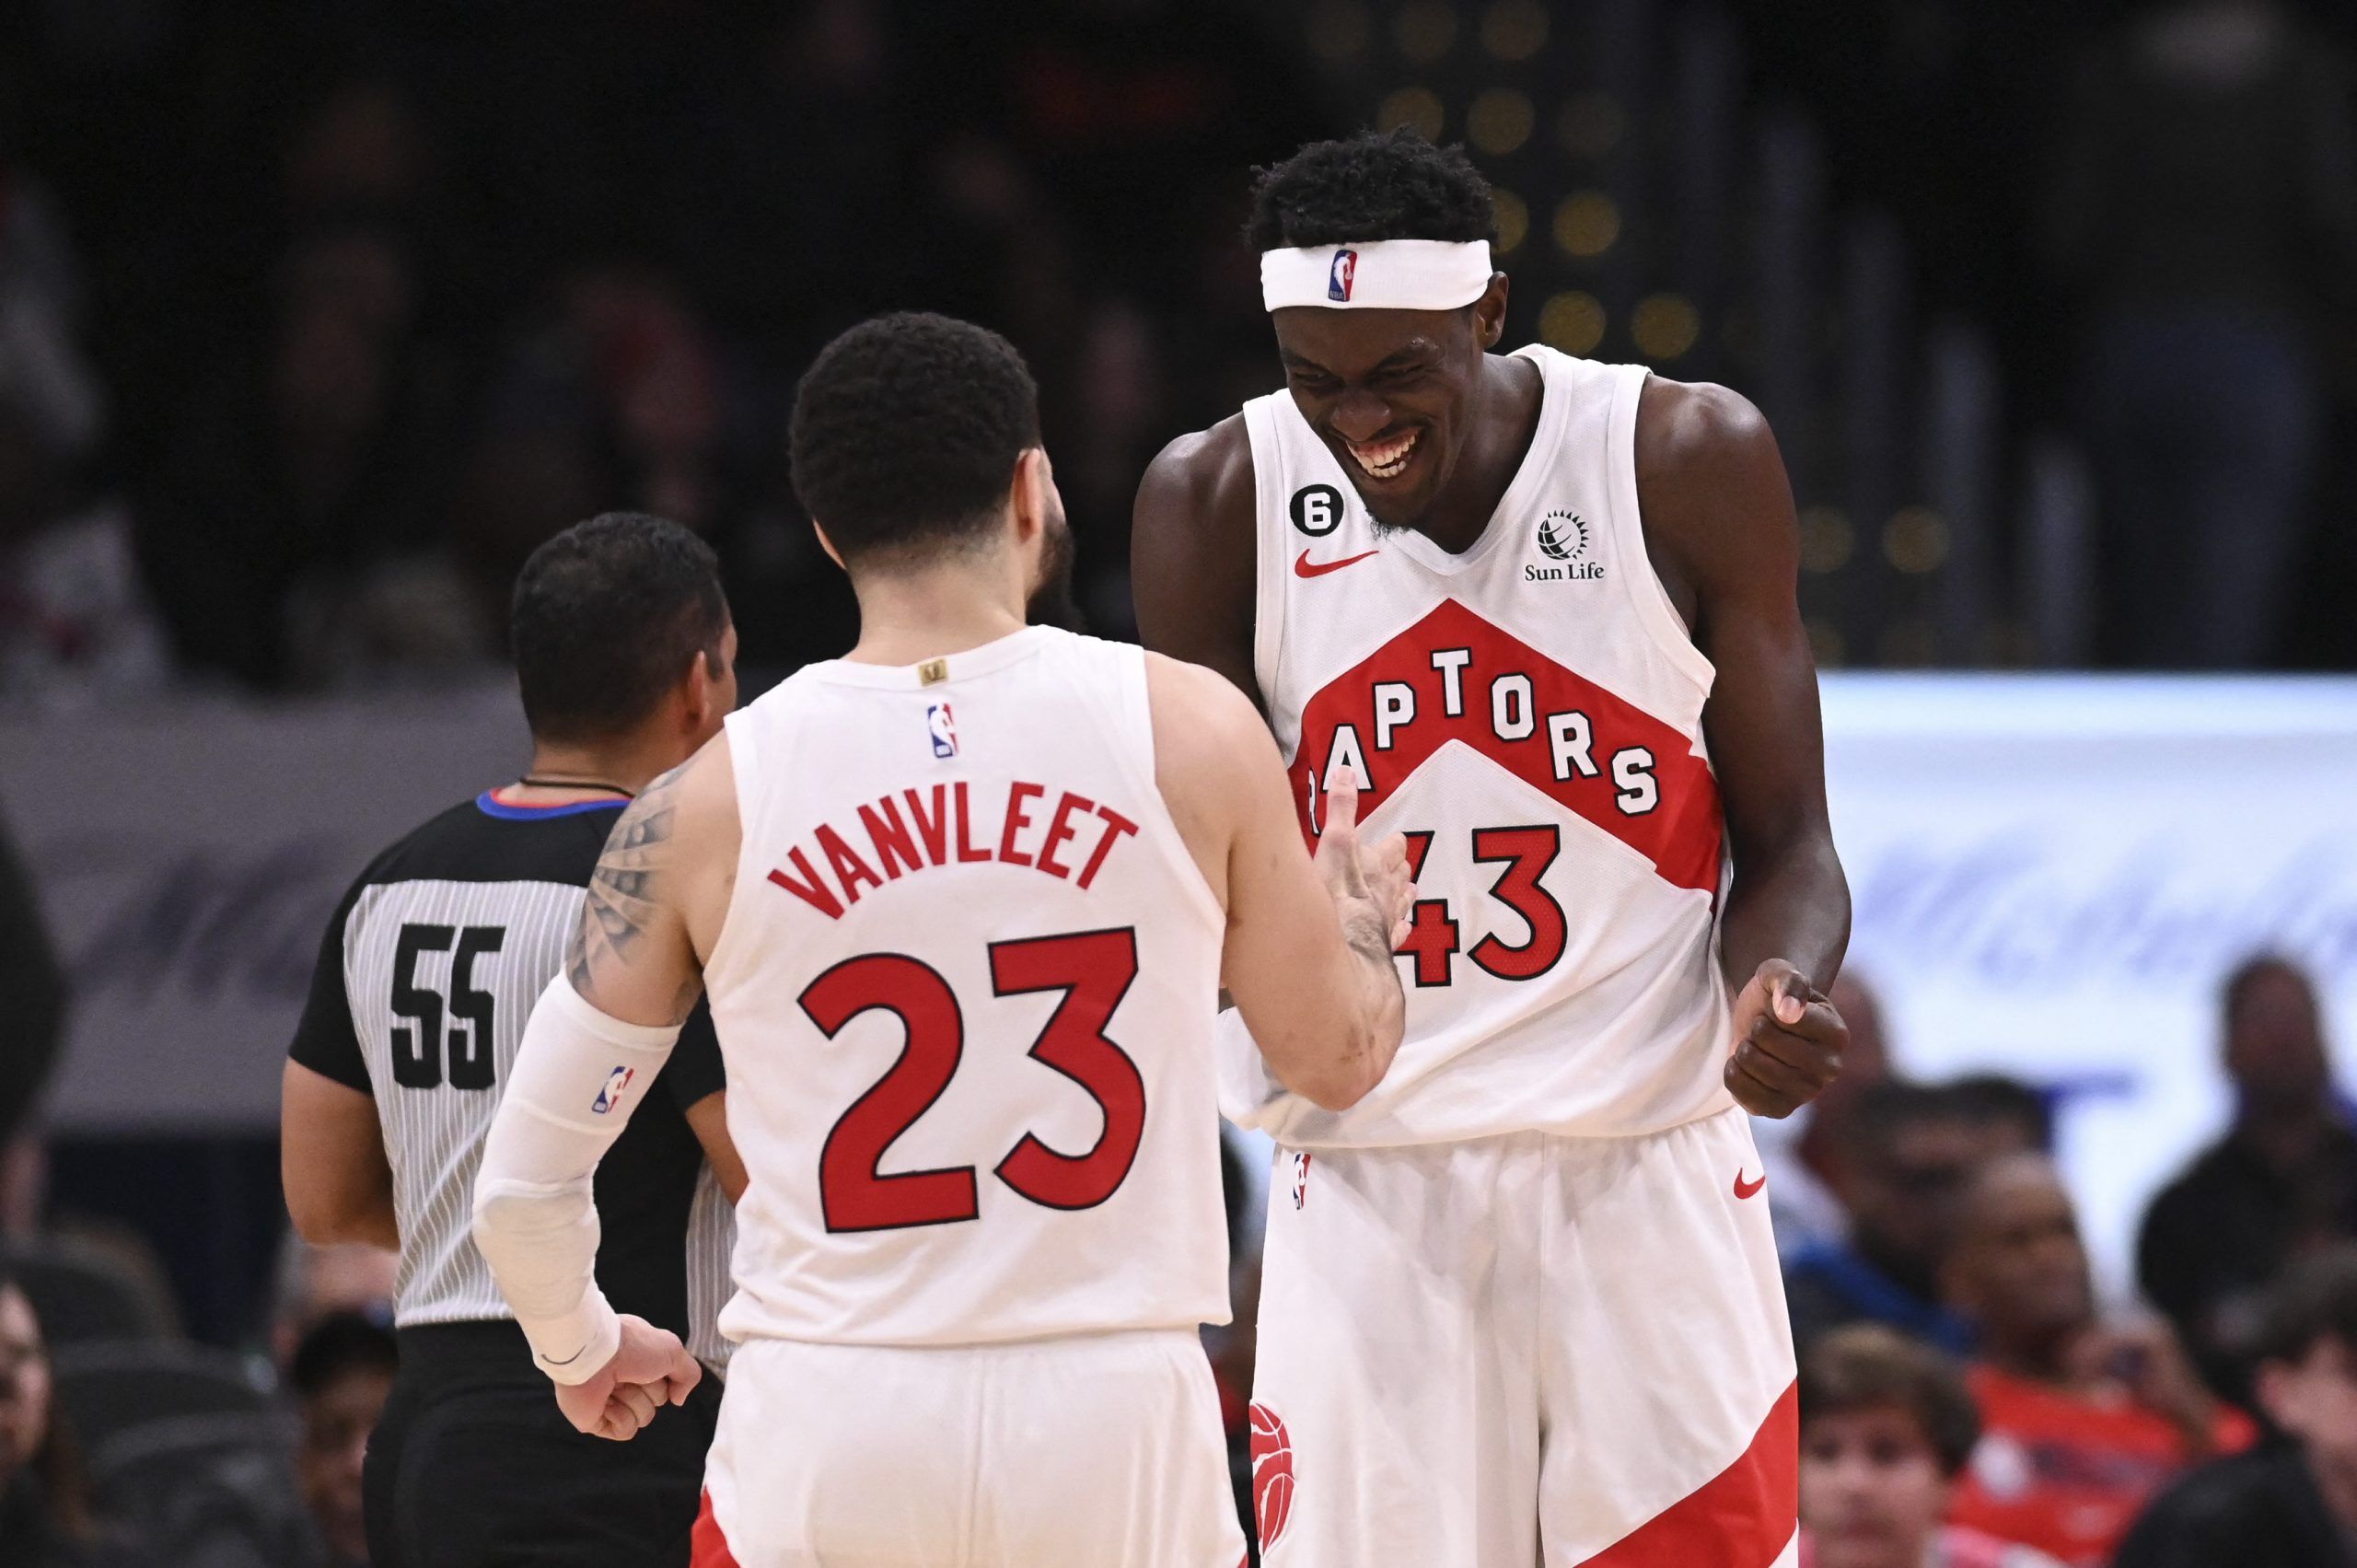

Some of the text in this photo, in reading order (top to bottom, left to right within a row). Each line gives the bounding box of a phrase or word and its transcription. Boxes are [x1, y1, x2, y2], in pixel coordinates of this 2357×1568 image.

[1304, 492, 1332, 530] 6
[1525, 562, 1605, 581] Sun Life
[767, 780, 1140, 921] VANVLEET
[390, 923, 506, 1090] 55
[796, 925, 1147, 1234] 23
